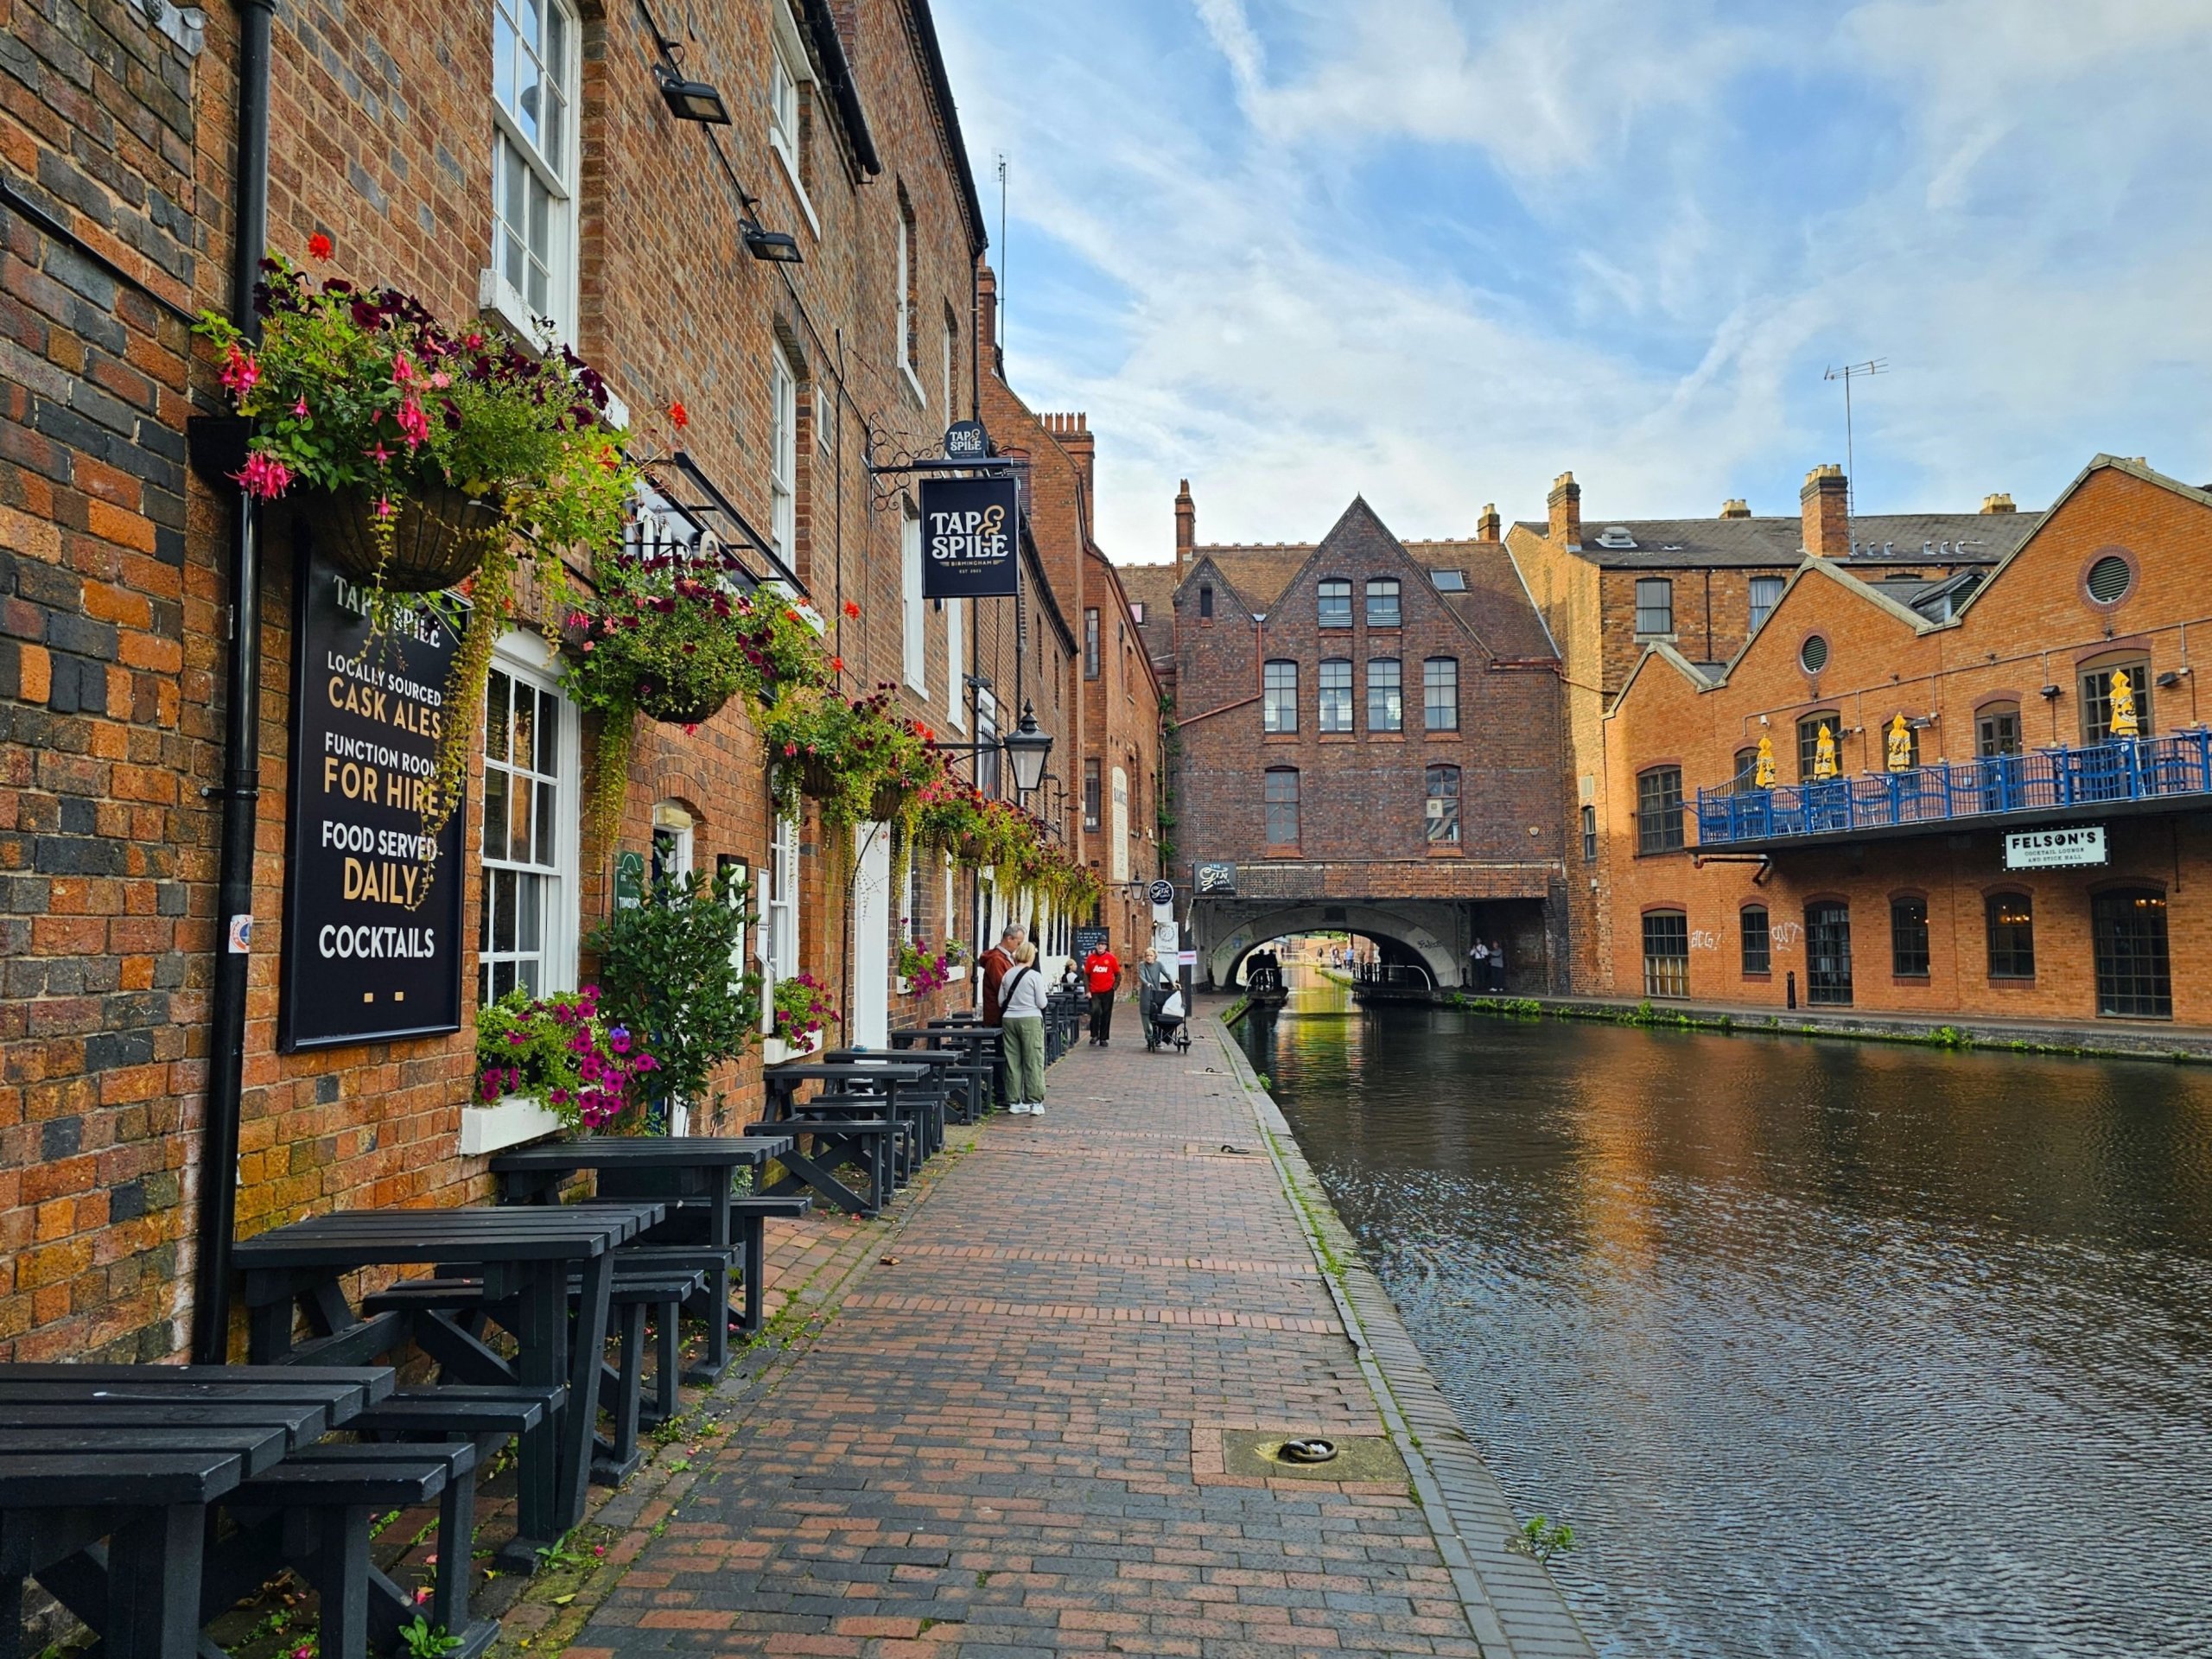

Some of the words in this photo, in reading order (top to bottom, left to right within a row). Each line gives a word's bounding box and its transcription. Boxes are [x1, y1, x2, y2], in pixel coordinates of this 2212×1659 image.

[949, 431, 970, 442] TAP
[969, 429, 980, 442] &
[950, 441, 982, 451] SPILE
[930, 511, 982, 535] TAP
[976, 505, 1005, 538] &
[931, 534, 1009, 559] SPILE
[327, 651, 385, 687] LOCALLY
[388, 673, 442, 707] SOURCED
[328, 676, 387, 723] CASK
[393, 699, 442, 740] ALES
[325, 731, 398, 778] FUNCTION
[324, 756, 378, 804] FOR
[386, 772, 439, 817] HIRE
[322, 820, 375, 854] FOOD
[378, 830, 437, 861] SERVED
[2012, 832, 2096, 849] FELSON'S
[344, 856, 419, 905] DAILY
[319, 925, 435, 958] COCKTAILS
